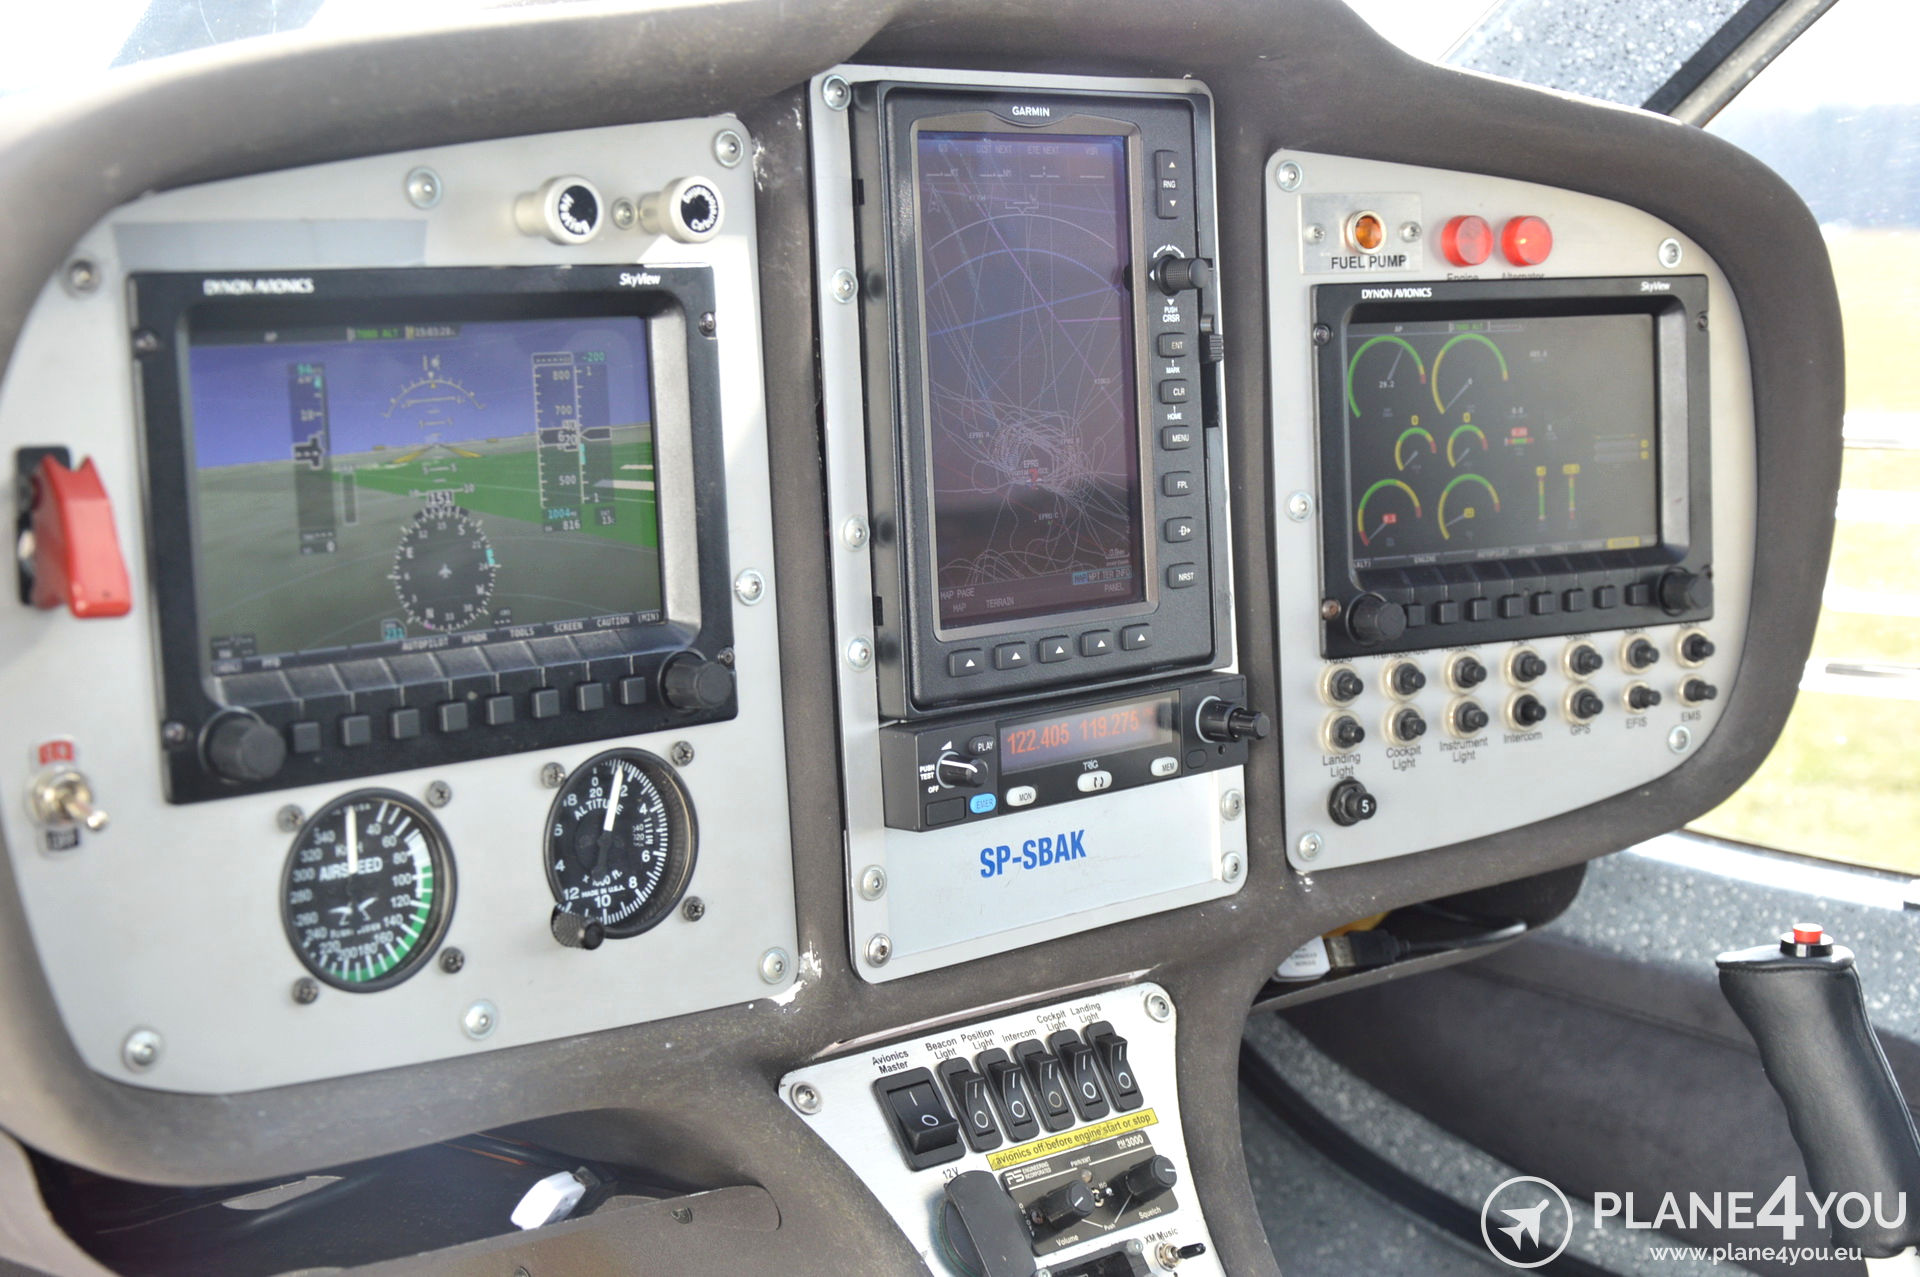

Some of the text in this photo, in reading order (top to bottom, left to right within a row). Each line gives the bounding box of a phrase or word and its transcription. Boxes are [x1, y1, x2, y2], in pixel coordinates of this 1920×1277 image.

[1012, 106, 1050, 117] GARMIN
[1163, 180, 1176, 188] RNG
[1331, 254, 1407, 269] FUEL PUMP
[619, 273, 661, 287] SkyView
[1361, 288, 1432, 299] DYNON AVIONICS
[1640, 282, 1670, 292] SkyView
[1163, 314, 1180, 323] CRSR
[1172, 342, 1183, 350] ENT
[1173, 388, 1185, 396] CLR
[555, 405, 572, 415] 700
[1167, 413, 1182, 421] HOME
[1172, 434, 1189, 442] MENU
[559, 475, 576, 486] 500
[1177, 481, 1188, 489] FPL
[563, 520, 580, 530] 816
[1178, 572, 1194, 581] NRST
[957, 587, 975, 598] PAGE
[597, 611, 660, 627] CAUTION (MIN)
[509, 627, 535, 638] TOOLS
[553, 622, 583, 633] SCREEN
[1681, 711, 1700, 721] EMS
[1080, 711, 1139, 741] 119.275
[1626, 717, 1647, 729] EFIS
[1570, 724, 1591, 736] GPS
[1007, 722, 1071, 755] 122.405
[1504, 731, 1542, 744] Intercom
[977, 741, 994, 752] PLAY
[1439, 738, 1488, 752] Instrument
[1386, 745, 1422, 759] Cockpit
[1452, 750, 1476, 764] Light
[1162, 762, 1175, 771] MEM
[1322, 753, 1361, 767] Landing
[1392, 758, 1416, 771] Light
[919, 764, 935, 773] PUSH
[1330, 766, 1354, 779] Light
[920, 772, 935, 780] TEST
[589, 786, 603, 799] 20
[620, 784, 628, 797] 2
[928, 785, 939, 793] OFF
[1019, 793, 1032, 802] MON
[574, 797, 624, 820] ALTITUE
[639, 803, 647, 815] 4
[1361, 800, 1369, 813] 5
[366, 823, 382, 836] 40
[382, 836, 398, 849] 60
[393, 852, 409, 864] 80
[642, 849, 650, 863] 6
[980, 829, 1086, 878] SP-SBAK
[319, 857, 383, 881] AIRSEED
[393, 873, 413, 887] 100
[628, 876, 638, 889] 8
[563, 886, 580, 901] 12
[581, 889, 599, 898] MADE
[391, 894, 411, 909] 120
[594, 893, 612, 908] 10
[383, 913, 404, 928] 140
[374, 930, 394, 945] 160
[358, 942, 378, 956] 180
[1070, 1002, 1101, 1016] Landing
[1036, 1010, 1066, 1024] Cockpit
[1079, 1012, 1100, 1024] Light
[1046, 1020, 1067, 1031] Light
[960, 1028, 994, 1042] Position
[1002, 1028, 1037, 1042] Intercom
[925, 1037, 957, 1052] Beacon
[972, 1038, 994, 1050] Light
[872, 1050, 909, 1066] Avionics
[934, 1048, 957, 1060] Light
[878, 1060, 909, 1074] Master
[995, 1113, 1151, 1165] avionics off before engine start or stop
[1022, 1161, 1049, 1173] ENGINEERING
[1024, 1167, 1052, 1180] INCORPORATED
[942, 1168, 959, 1180] 12V
[1138, 1206, 1162, 1220] Squelch
[1056, 1234, 1079, 1247] Volume
[1144, 1228, 1178, 1244] XM Music
